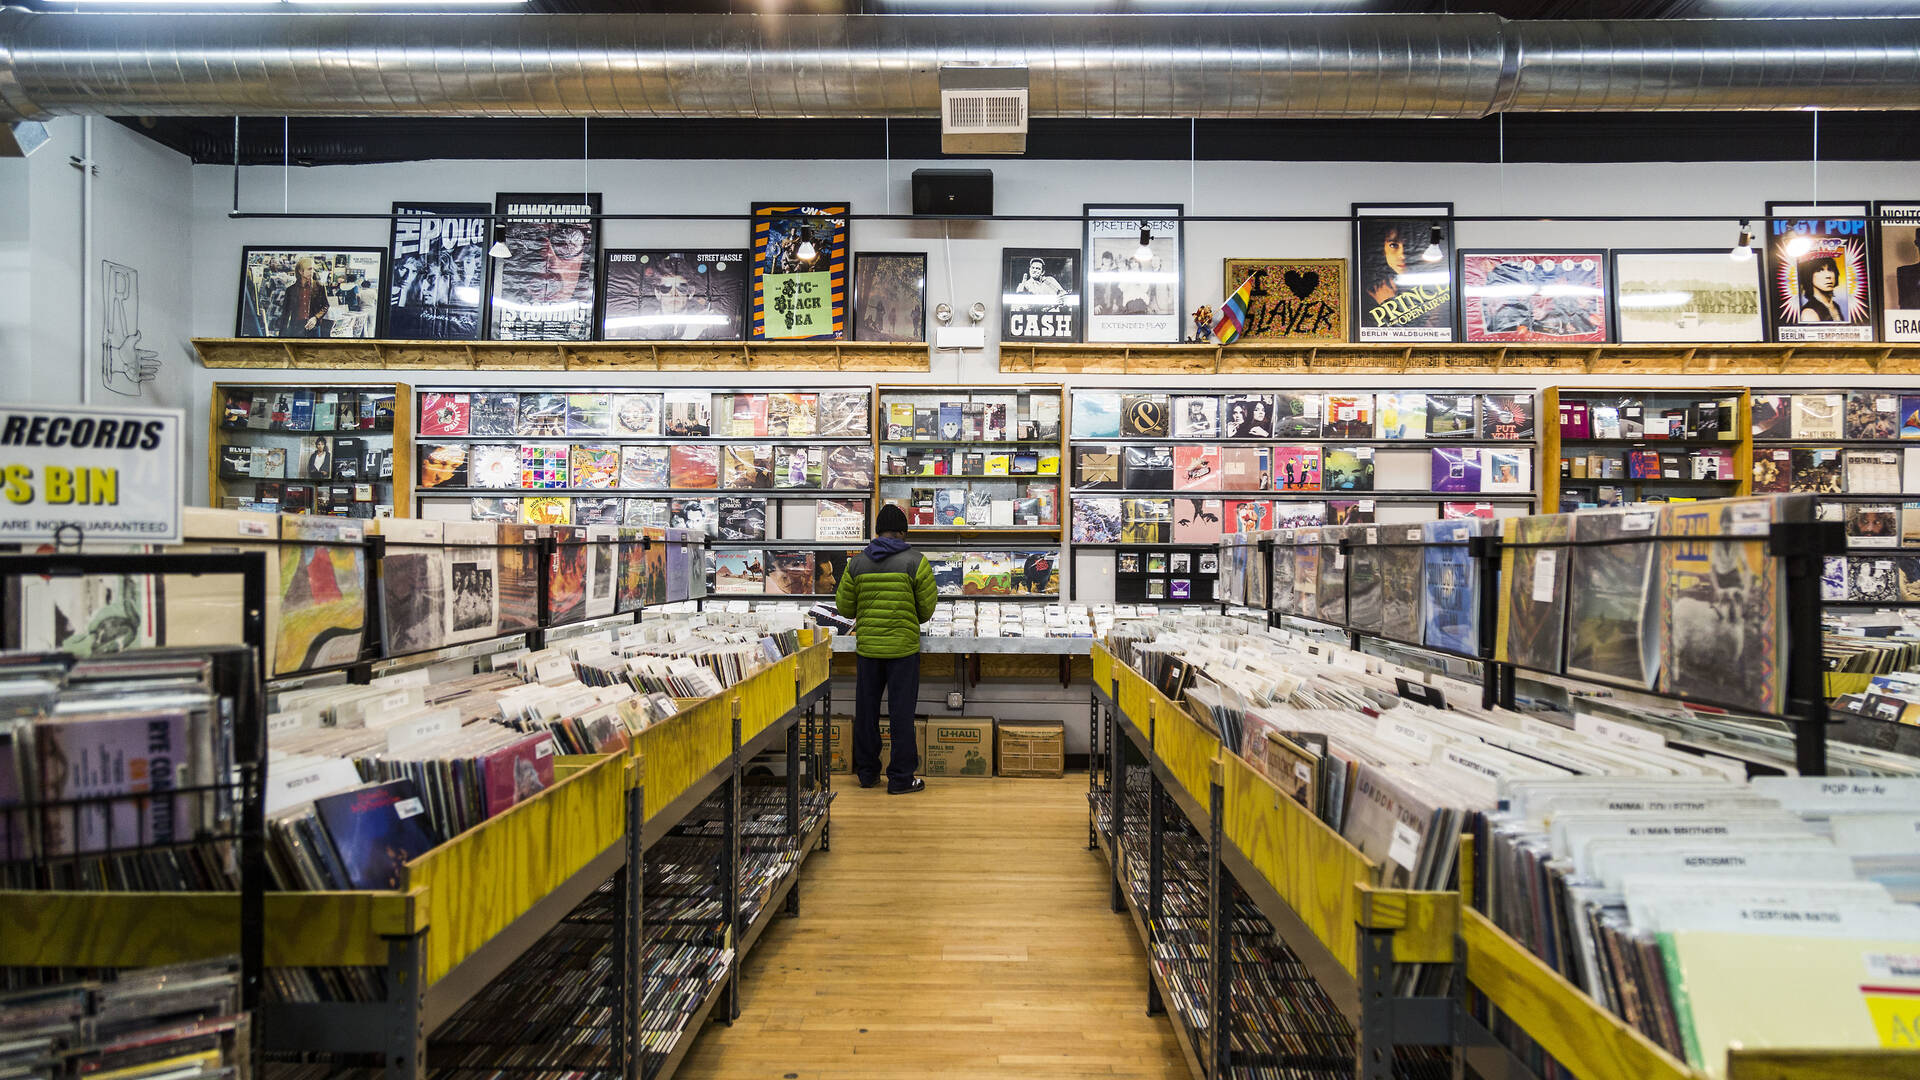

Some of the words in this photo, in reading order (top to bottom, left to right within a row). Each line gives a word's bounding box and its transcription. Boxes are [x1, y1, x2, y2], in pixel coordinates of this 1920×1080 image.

[507, 204, 592, 223] HAWKWIND
[419, 211, 485, 254] POLICE
[1824, 220, 1865, 235] POP
[1247, 269, 1268, 296] I
[774, 295, 821, 314] BLACK
[1398, 307, 1424, 325] OPEN
[1424, 299, 1441, 312] AIR
[785, 311, 813, 330] SEA
[1010, 314, 1071, 337] CASH
[1146, 321, 1167, 329] PLAY
[1894, 319, 1920, 334] GRA
[1, 415, 164, 450] RECORDS
[0, 464, 35, 505] S
[44, 465, 119, 506] BIN
[1, 520, 31, 531] ARE
[36, 520, 65, 532] NOT
[74, 521, 168, 533] GUARANTEED
[940, 730, 978, 738] U-HAUL
[1359, 781, 1394, 812] LONDON
[1396, 804, 1425, 835] TOWN
[1685, 857, 1746, 865] AEROSMITH
